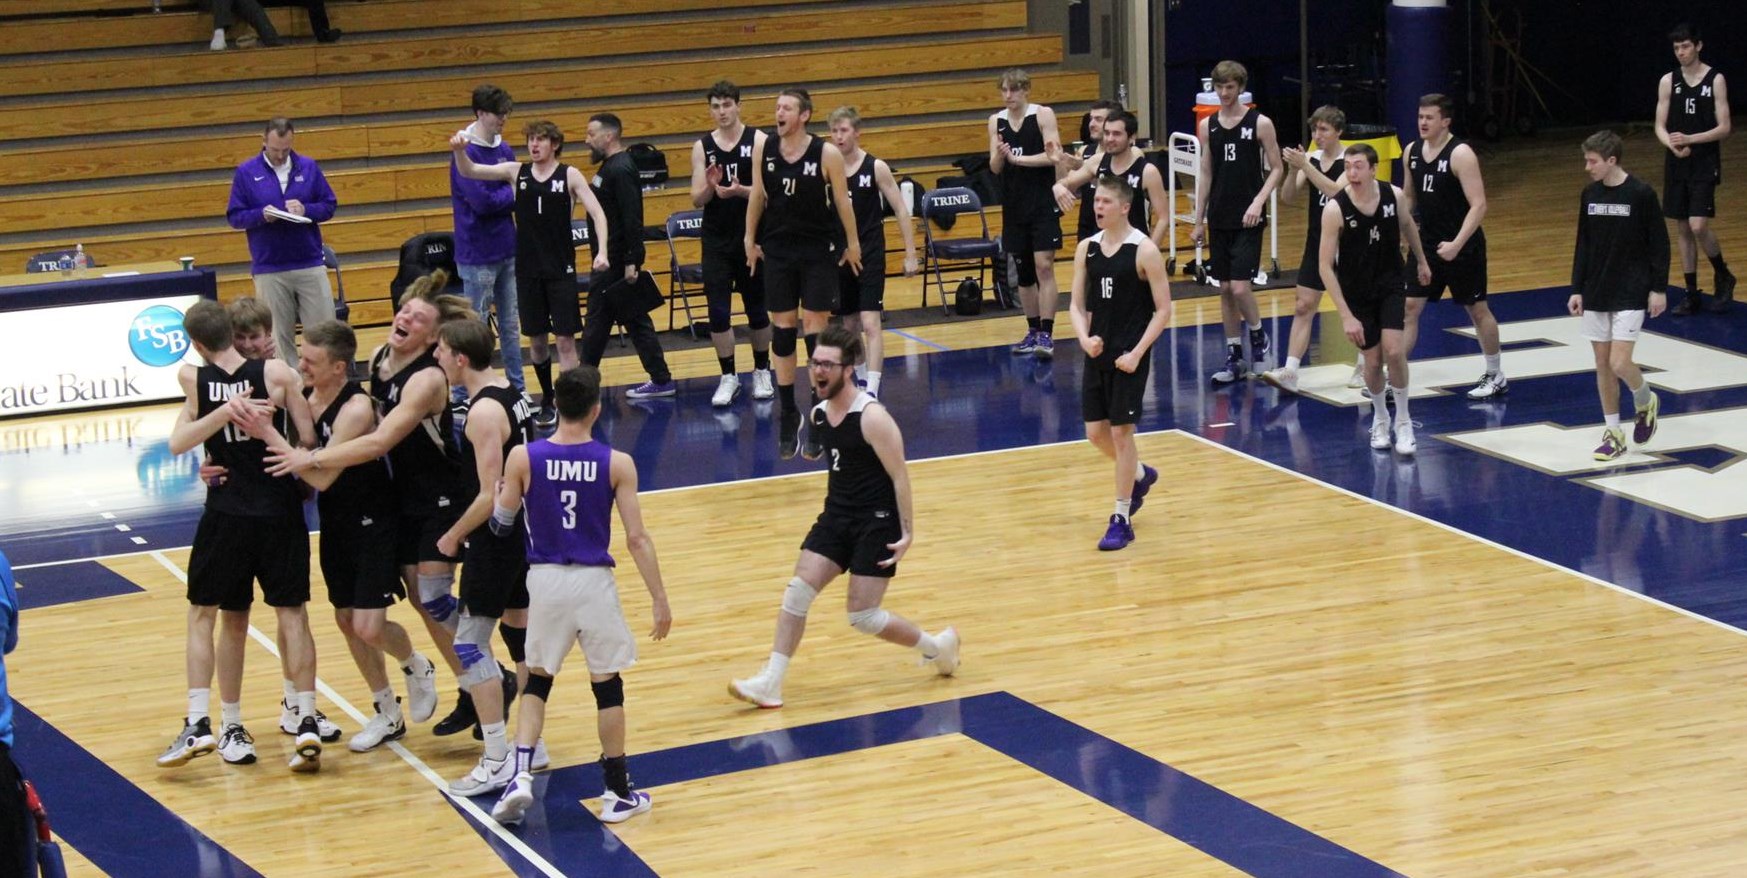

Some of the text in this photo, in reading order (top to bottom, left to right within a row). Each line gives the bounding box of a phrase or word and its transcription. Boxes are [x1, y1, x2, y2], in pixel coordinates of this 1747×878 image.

[1701, 85, 1712, 97] M
[1685, 98, 1696, 115] 15
[1241, 127, 1253, 140] M
[740, 145, 752, 157] M
[1224, 143, 1236, 161] 13
[726, 163, 738, 182] 17
[803, 161, 818, 176] M
[1437, 159, 1448, 172] M
[551, 180, 564, 192] M
[782, 178, 796, 195] 21
[859, 174, 871, 187] M
[1127, 174, 1140, 188] M
[1422, 173, 1434, 192] 12
[537, 195, 542, 215] 1
[931, 194, 971, 207] TRINE
[1383, 203, 1395, 218] M
[1369, 225, 1380, 245] 14
[1101, 277, 1113, 299] 16
[134, 316, 188, 354] FSB
[57, 366, 143, 404] Bank
[831, 448, 841, 471] 2
[545, 459, 598, 482] UMU
[560, 490, 577, 529] 3
